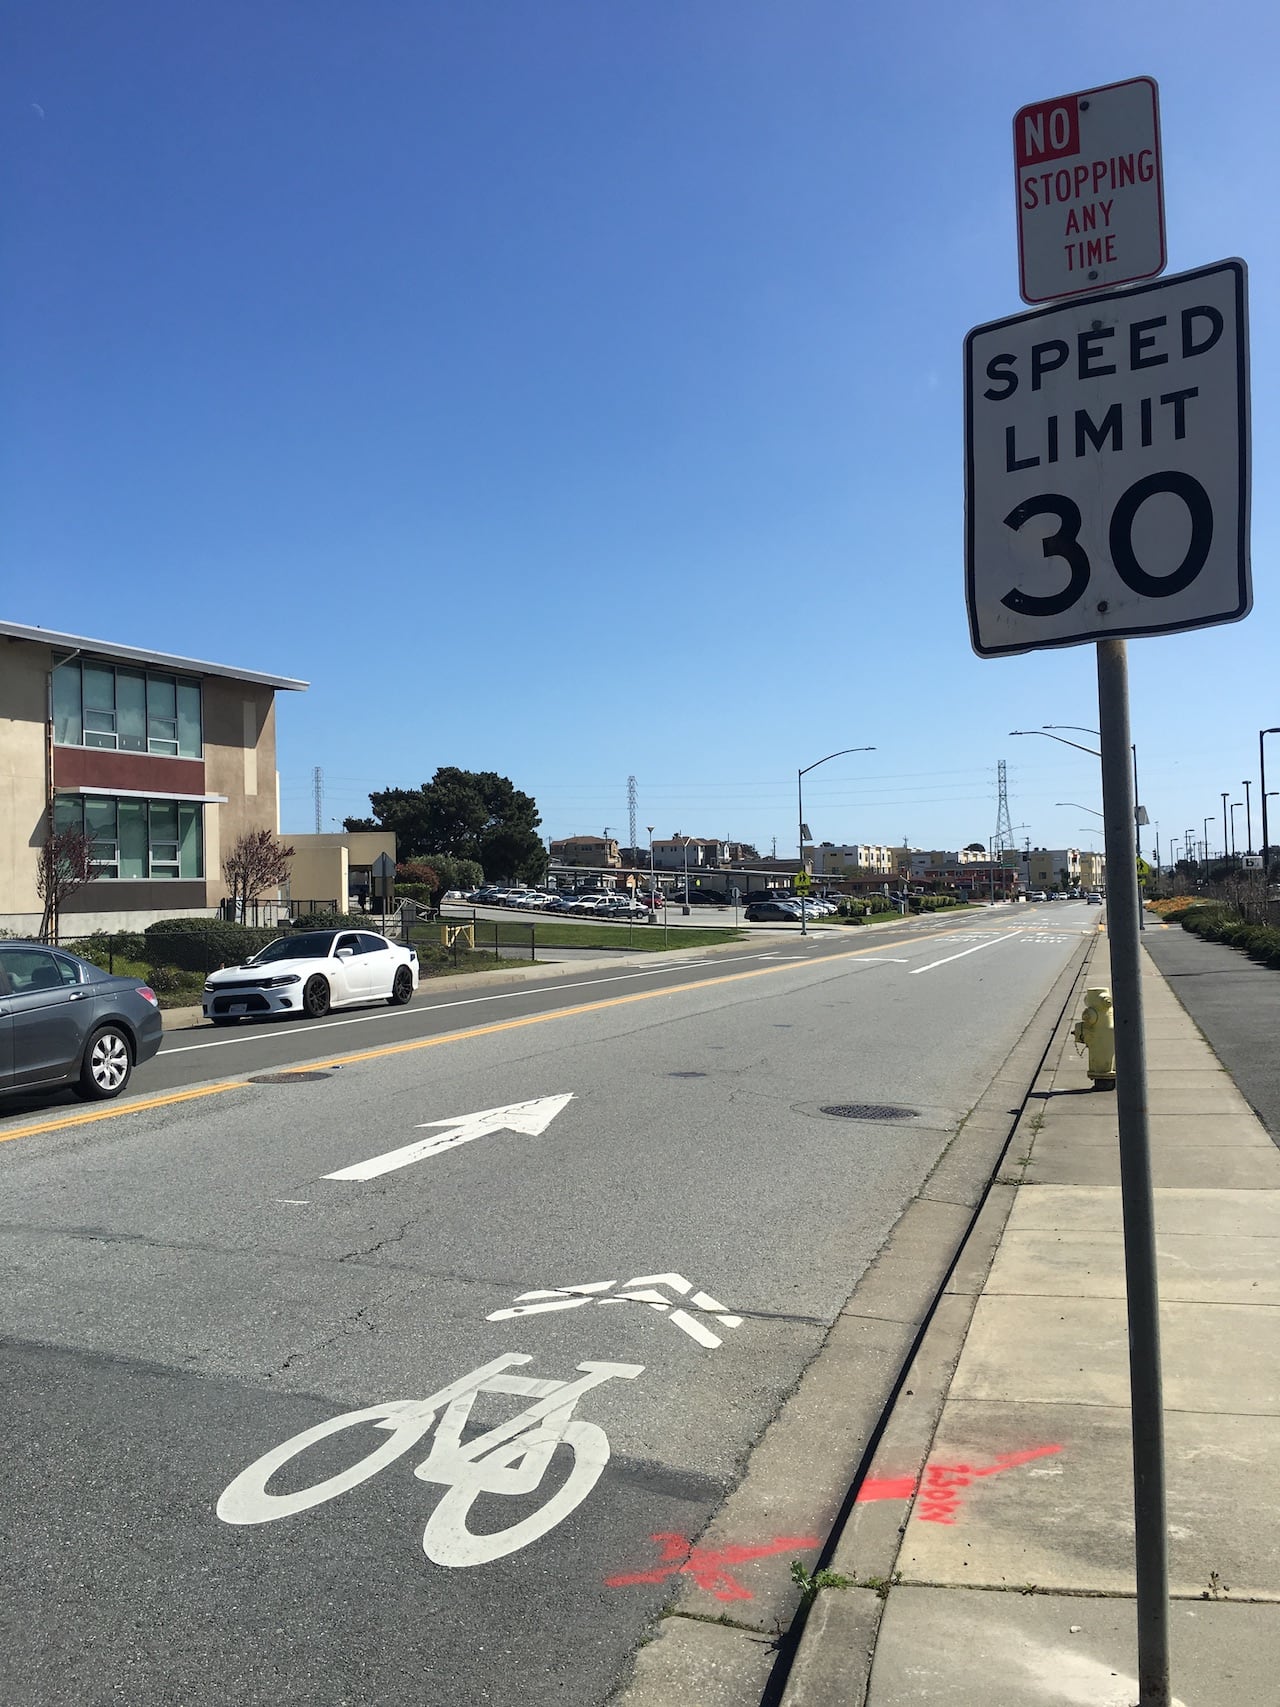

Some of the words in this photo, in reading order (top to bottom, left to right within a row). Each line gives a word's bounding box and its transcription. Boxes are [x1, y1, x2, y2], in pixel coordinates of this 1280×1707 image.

[1024, 108, 1070, 156] NO
[1024, 150, 1154, 210] STOPPING
[1065, 200, 1114, 236] ANY
[1064, 235, 1117, 271] TIME
[983, 305, 1224, 401] SPEED
[1006, 387, 1199, 473] LIMIT
[1000, 471, 1213, 616] 30
